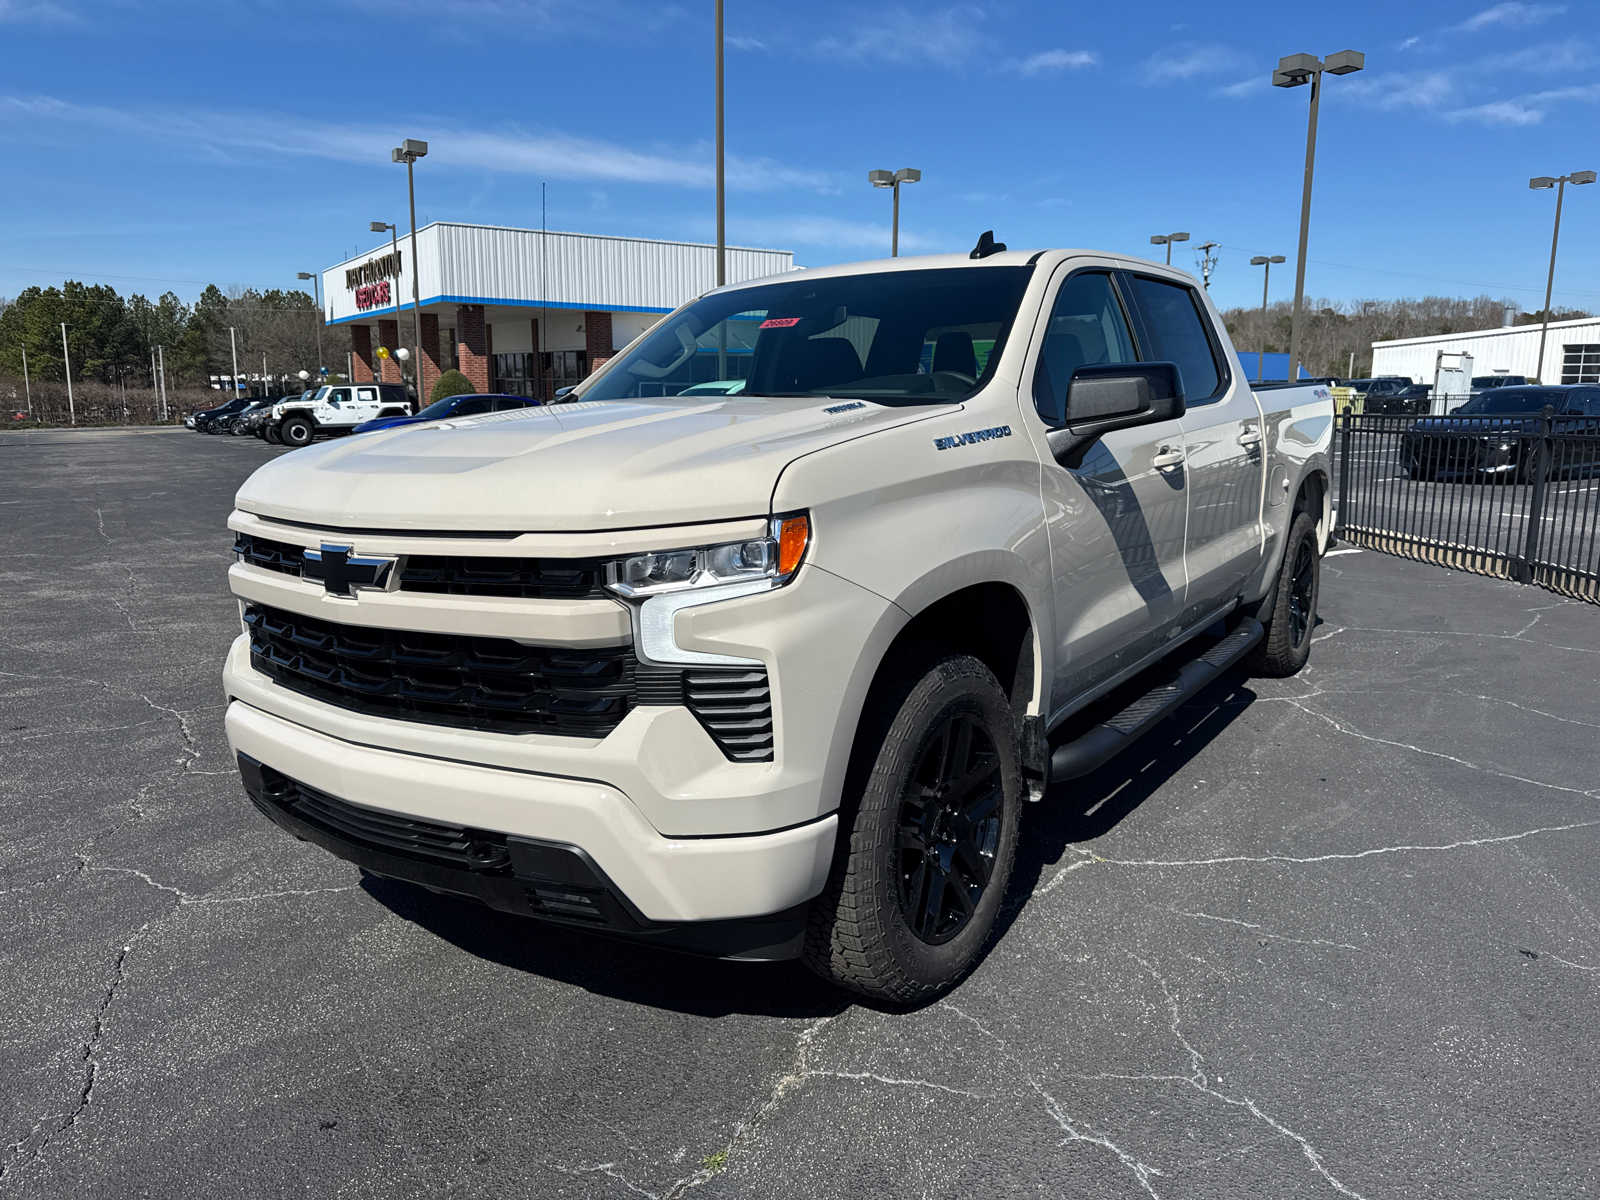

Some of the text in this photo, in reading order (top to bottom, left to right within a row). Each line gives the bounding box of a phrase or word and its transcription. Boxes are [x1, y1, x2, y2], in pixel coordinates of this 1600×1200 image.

[355, 281, 391, 309] USED CARS
[765, 319, 793, 327] 26809
[933, 425, 1012, 451] SILVERADO
